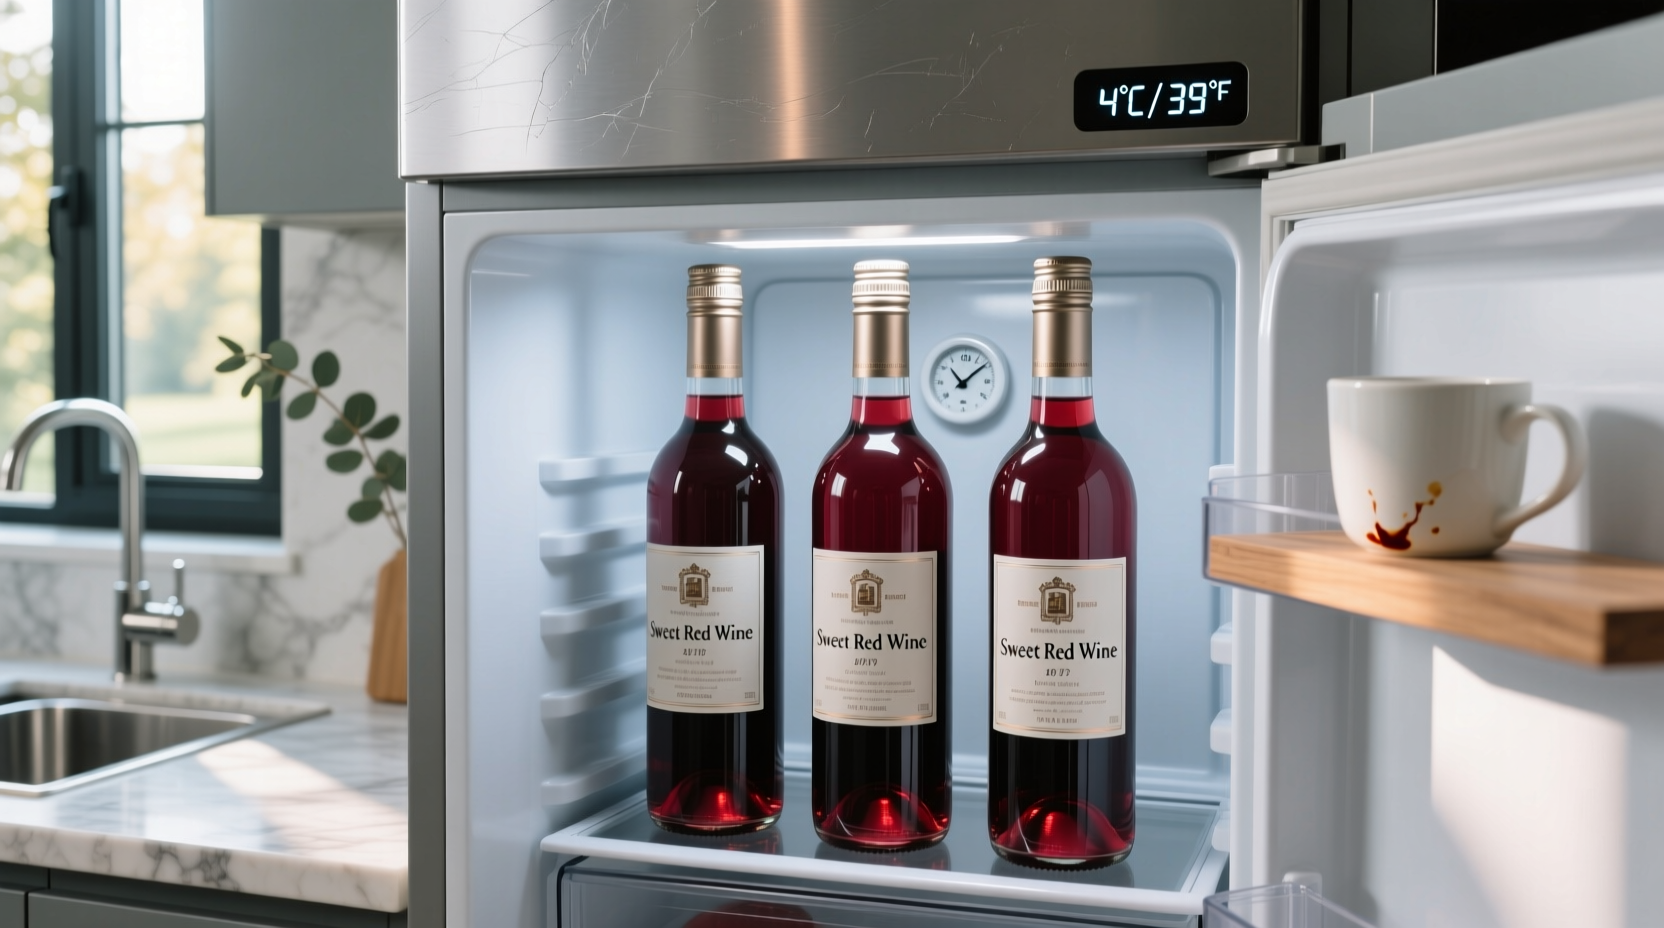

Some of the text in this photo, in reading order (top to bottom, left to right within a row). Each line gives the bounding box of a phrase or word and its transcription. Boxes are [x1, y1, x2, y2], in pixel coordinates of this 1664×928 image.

[650, 620, 753, 641] Sweet Red Wine
[817, 628, 927, 651] Sweet Red Wine
[1000, 637, 1118, 660] Sweet Red Wine
